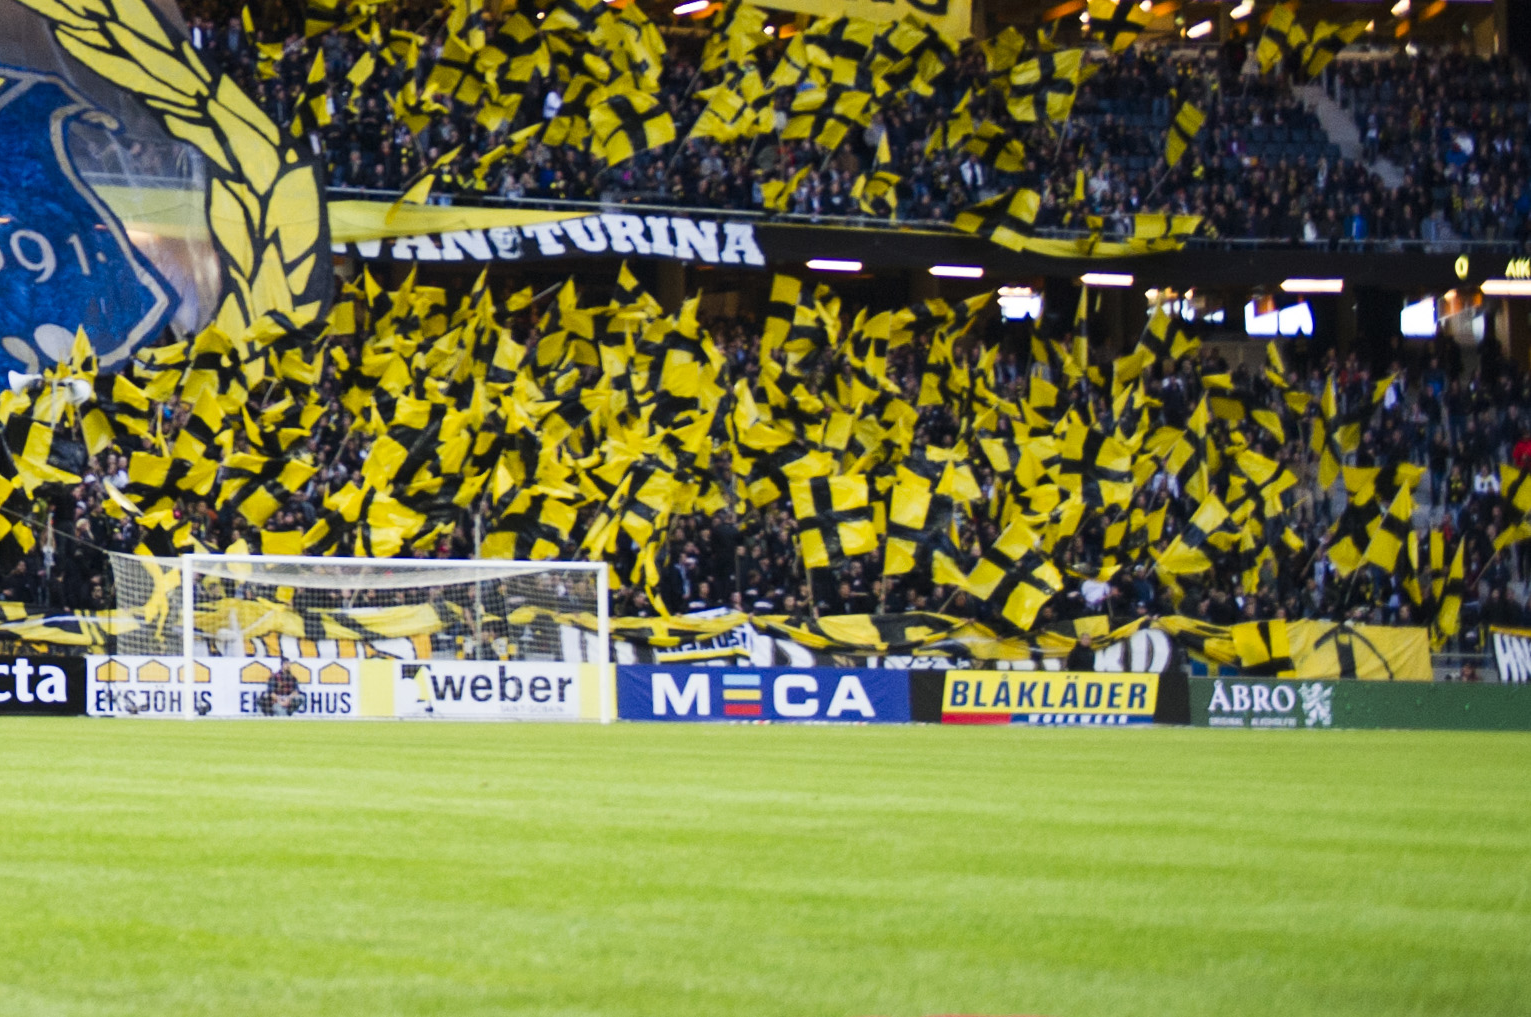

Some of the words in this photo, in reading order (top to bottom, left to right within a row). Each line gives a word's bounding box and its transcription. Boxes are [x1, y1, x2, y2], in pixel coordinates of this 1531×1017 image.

[521, 213, 767, 267] TURINA
[239, 687, 352, 714] EÖHUS
[430, 664, 573, 703] weber
[650, 672, 876, 718] MECA
[949, 674, 1149, 710] BLÅKLÄDER
[1208, 679, 1296, 712] ÅBRO
